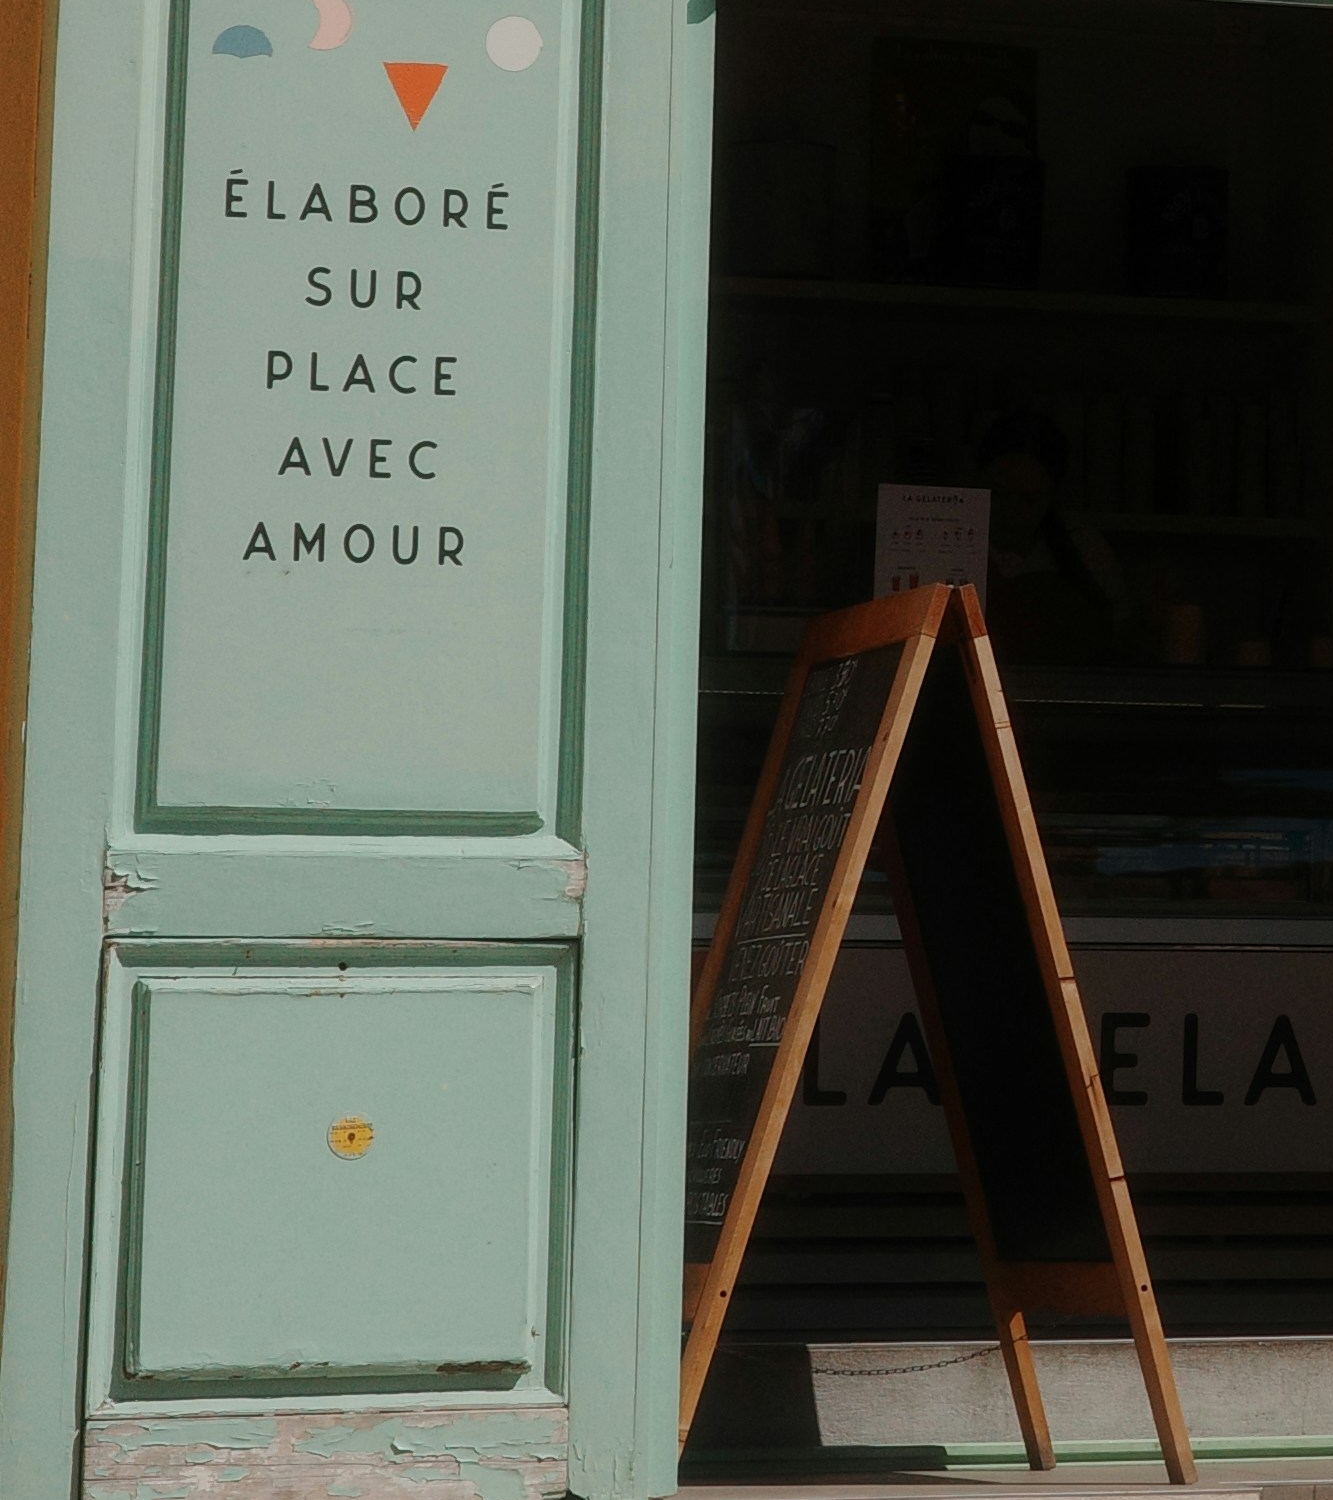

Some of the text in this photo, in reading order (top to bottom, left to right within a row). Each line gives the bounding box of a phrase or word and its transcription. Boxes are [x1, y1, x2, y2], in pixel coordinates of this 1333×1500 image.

[224, 168, 512, 231] ÉLABORÉ
[304, 266, 424, 311] SUR
[265, 350, 459, 397] PLACE
[277, 436, 440, 481] AVEC
[242, 521, 466, 567] AMOUR
[803, 1012, 945, 1106] LA
